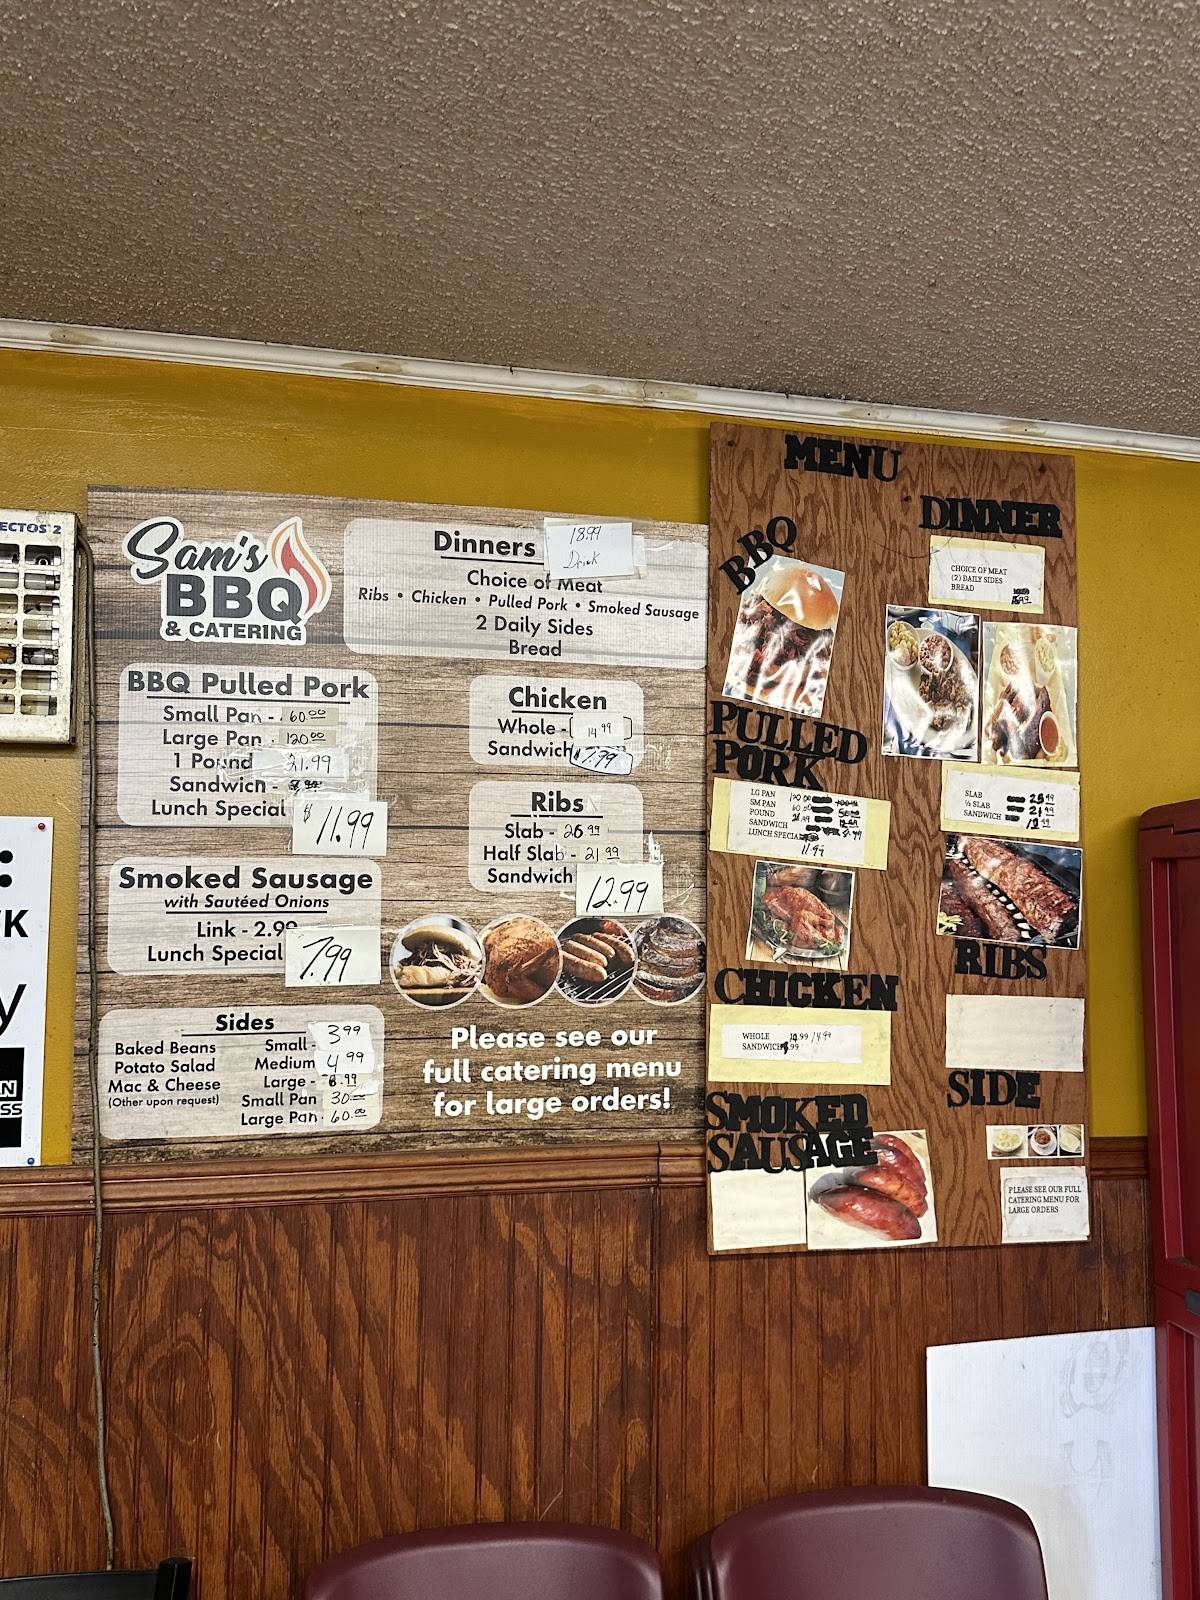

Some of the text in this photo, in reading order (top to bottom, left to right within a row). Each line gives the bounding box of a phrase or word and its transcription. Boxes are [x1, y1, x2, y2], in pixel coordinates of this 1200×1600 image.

[784, 435, 901, 482] MENU
[919, 495, 1063, 538] DINNER
[53, 525, 62, 534] 2
[570, 525, 602, 545] 18.99
[127, 521, 268, 579] Sam's
[434, 530, 536, 557] Dinners
[719, 516, 797, 595] BBQ
[951, 565, 1007, 575] CHOICE OF MEAT
[951, 574, 1003, 584] (2) DAILY SIDES
[467, 569, 603, 594] Choice of Meat
[166, 574, 303, 625] BBQ
[358, 587, 700, 622] Ribs Chicken Pulled Pork Smoked Sausage
[166, 621, 302, 641] & CATERING
[476, 615, 594, 638] 2 Daily Sides
[509, 640, 562, 657] Bread
[128, 671, 370, 699] BBQ Pulled Pork
[509, 685, 607, 710] Chicken
[163, 705, 218, 722] Small
[226, 707, 261, 724] Pan
[498, 717, 556, 735] Whole
[709, 701, 868, 764] PULLED
[163, 729, 218, 749] Large
[227, 731, 261, 747] Pan
[488, 740, 572, 757] Sandwich
[174, 753, 180, 767] 1
[192, 753, 253, 769] Pound
[712, 740, 824, 791] PORK
[170, 775, 266, 793] Sandwich
[750, 788, 760, 796] LG
[762, 789, 776, 798] PAN
[531, 791, 584, 812] Ribs
[965, 790, 982, 798] SLAB
[151, 799, 286, 820] Lunch Special
[750, 799, 761, 807] SM
[762, 799, 776, 808] PAN
[973, 801, 991, 809] SLAB
[749, 808, 775, 818] POUND
[964, 810, 1001, 821] SANDWICH
[505, 823, 543, 839] Slab
[749, 818, 788, 829] SANDWICH
[748, 828, 773, 838] LUNCH
[484, 845, 520, 861] Half
[527, 845, 564, 861] Slab
[119, 866, 373, 895] Smoked Sausage
[488, 867, 573, 884] Sandwich
[164, 893, 329, 908] with Sautéed Onions
[586, 875, 649, 913] 12.99
[197, 921, 236, 938] Link
[148, 943, 283, 966] Lunch Special
[954, 939, 1048, 981] RIBS
[714, 968, 898, 1012] CHICKEN
[216, 1012, 274, 1031] Sides
[265, 1037, 307, 1051] Small
[451, 1025, 658, 1050] Please see our
[742, 1032, 770, 1040] WHOLE
[115, 1040, 216, 1055] Baked Beans
[115, 1057, 215, 1074] Potato Salad
[254, 1056, 315, 1070] Medium
[423, 1056, 682, 1086] full catering menu
[108, 1077, 221, 1093] Mac & Cheese
[264, 1076, 306, 1090] Large
[947, 1071, 1041, 1109] SIDE
[108, 1094, 219, 1108] (Other upon request)
[241, 1092, 284, 1107] Small
[290, 1093, 317, 1105] Pan
[433, 1087, 671, 1120] for large orders!
[241, 1113, 283, 1128] Large
[290, 1111, 317, 1123] Pan
[705, 1091, 868, 1134] SMOKED
[707, 1122, 878, 1174] SAUSAGE
[1008, 1186, 1033, 1194] PLEASE
[1048, 1185, 1063, 1193] OUR
[1064, 1185, 1081, 1193] FULL
[1008, 1196, 1042, 1204] CATERING
[1008, 1206, 1029, 1214] LARGE
